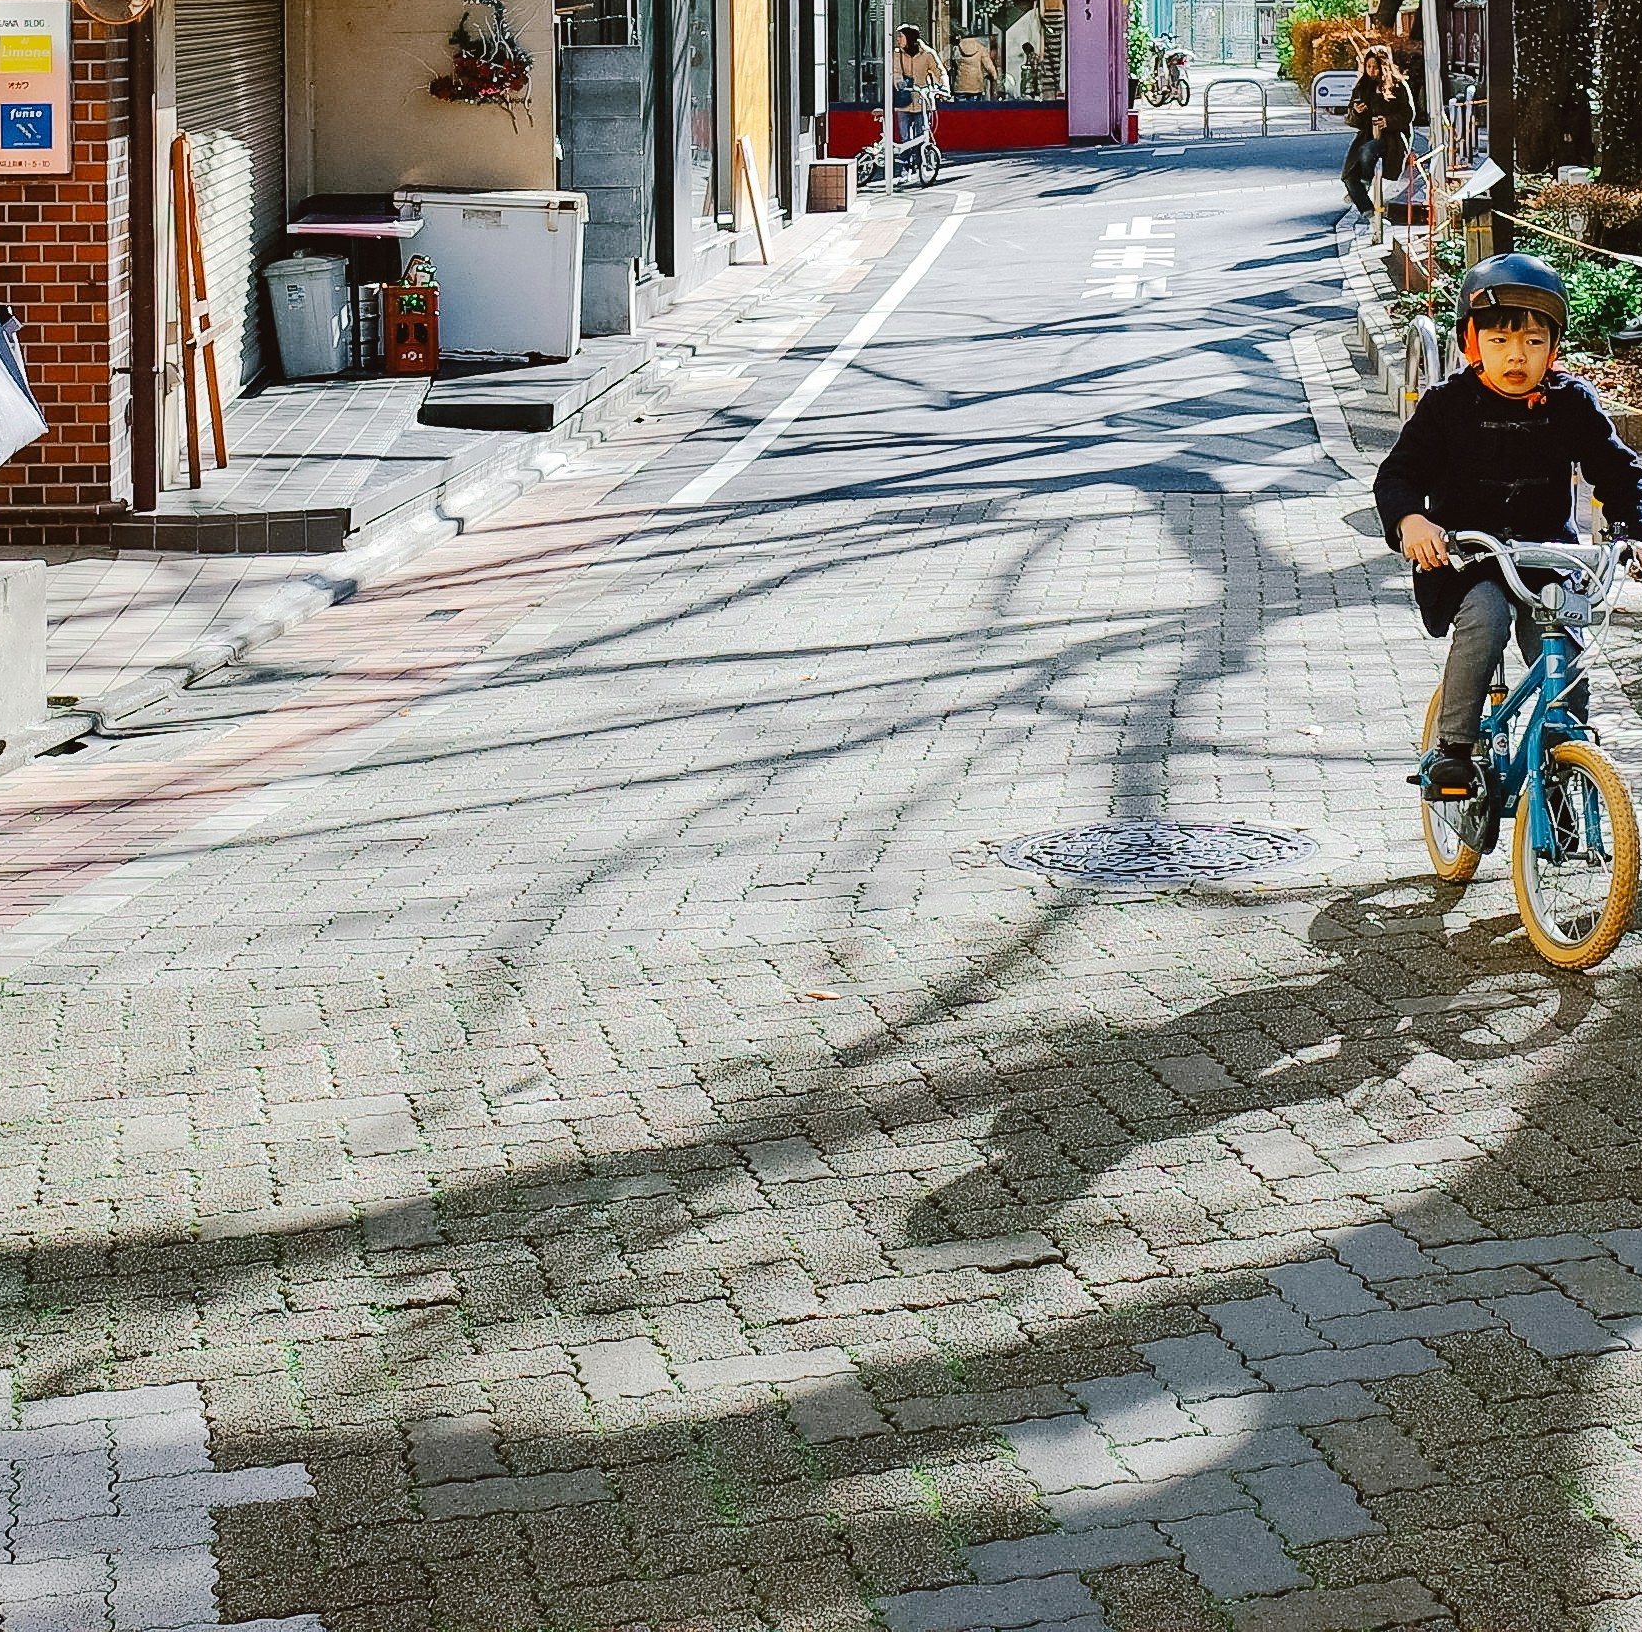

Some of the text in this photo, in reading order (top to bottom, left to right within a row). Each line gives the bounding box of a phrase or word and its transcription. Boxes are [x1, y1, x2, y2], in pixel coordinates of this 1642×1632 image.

[2, 45, 50, 57] Limone
[1080, 215, 1177, 300] 止まれ
